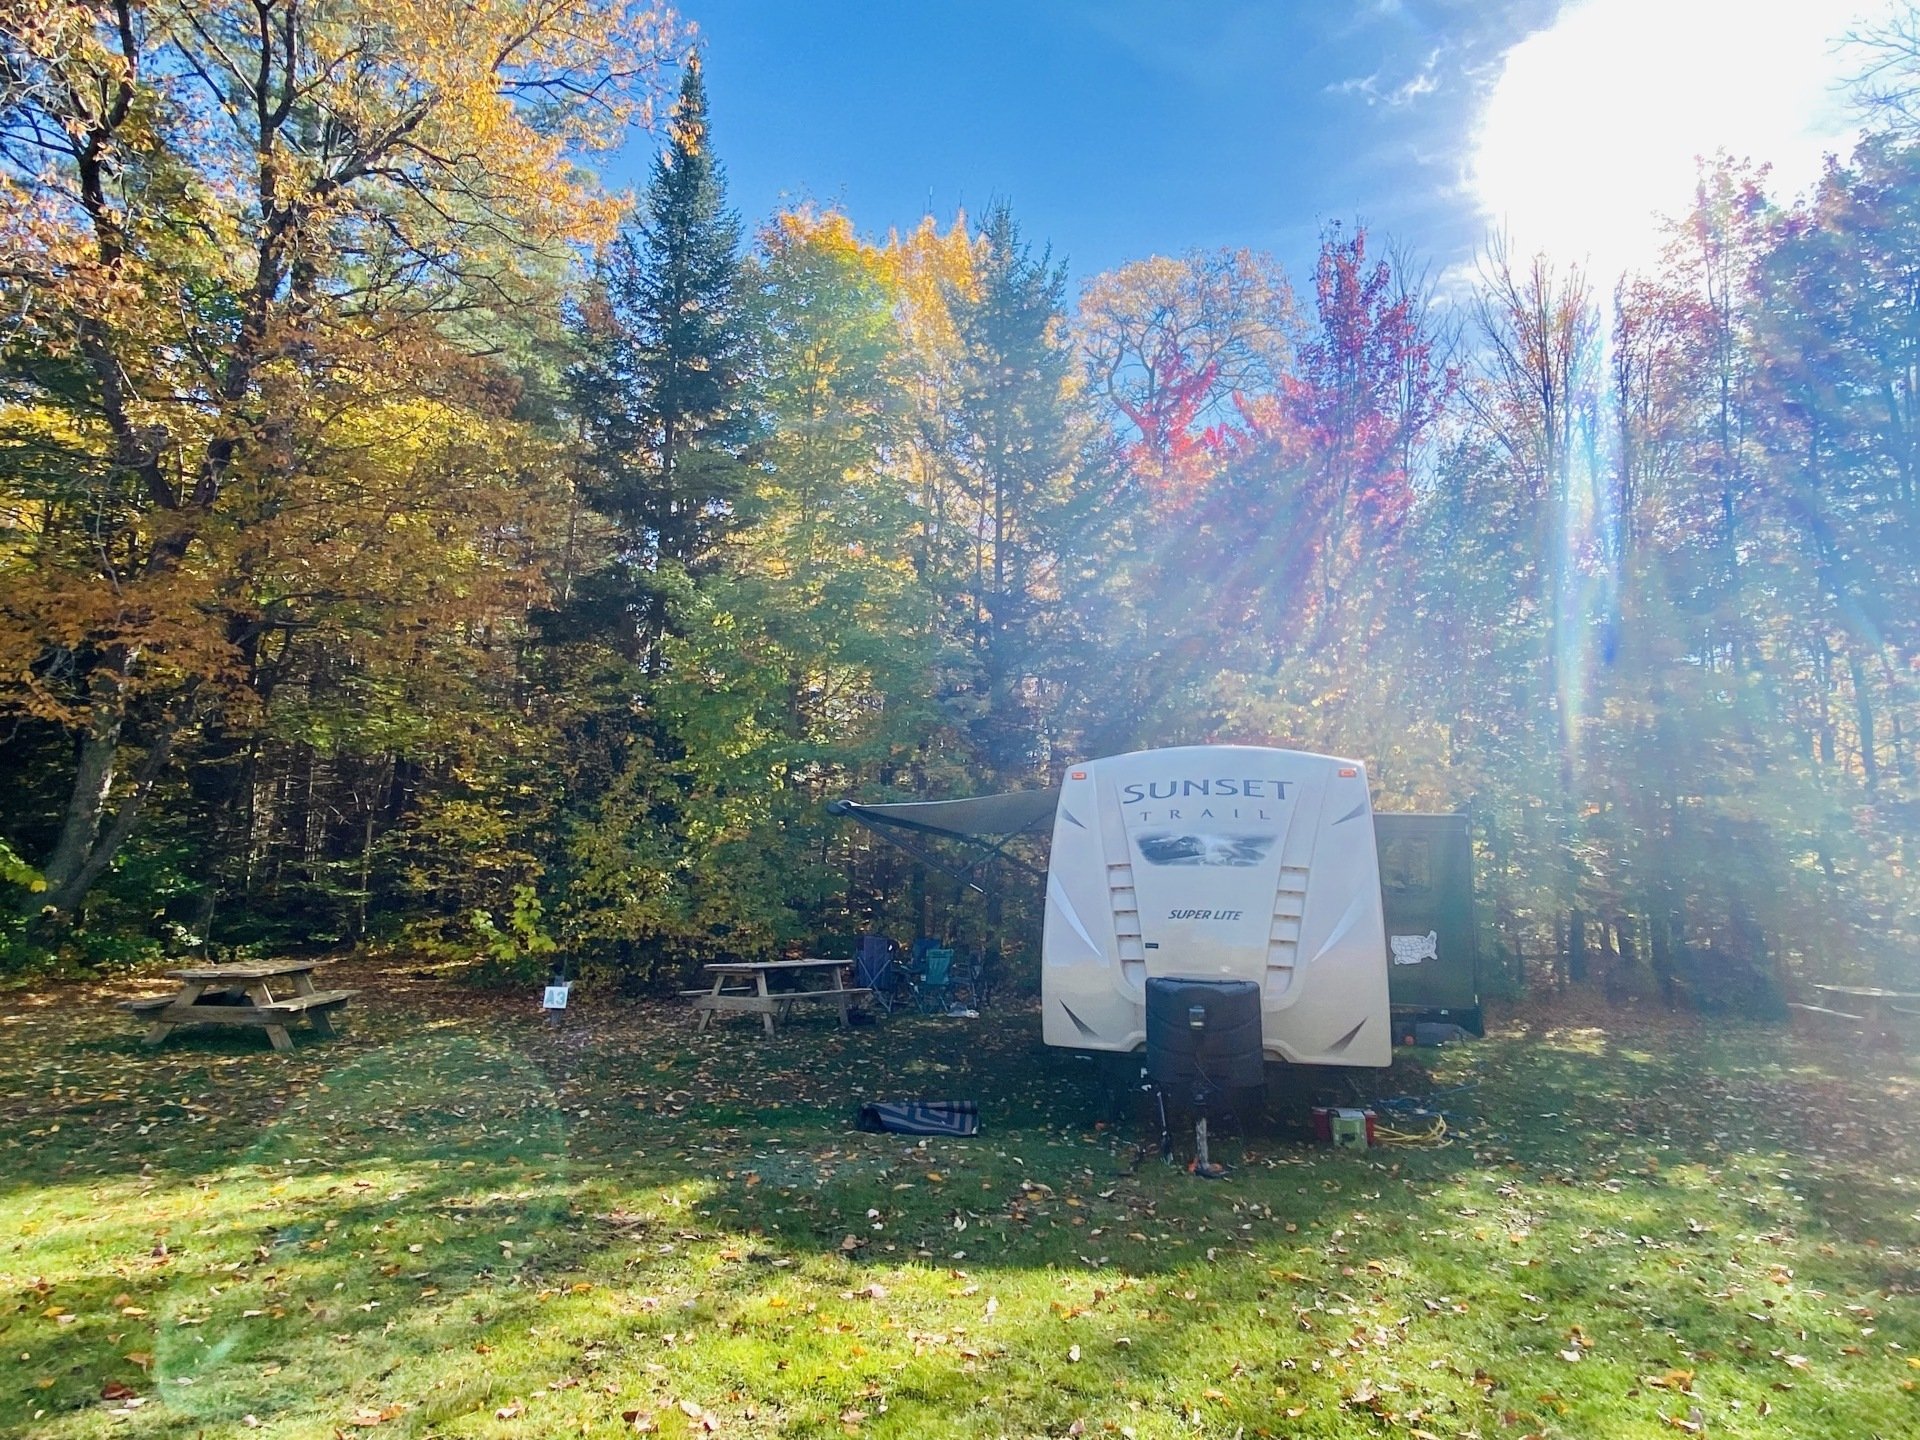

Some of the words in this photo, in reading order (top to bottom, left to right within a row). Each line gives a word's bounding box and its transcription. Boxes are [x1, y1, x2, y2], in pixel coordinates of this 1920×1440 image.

[1122, 779, 1293, 804] SUNSET
[1140, 808, 1271, 821] TRAIL
[1168, 909, 1212, 919] SUPER
[1213, 910, 1243, 920] LITE
[545, 989, 566, 1005] A3
